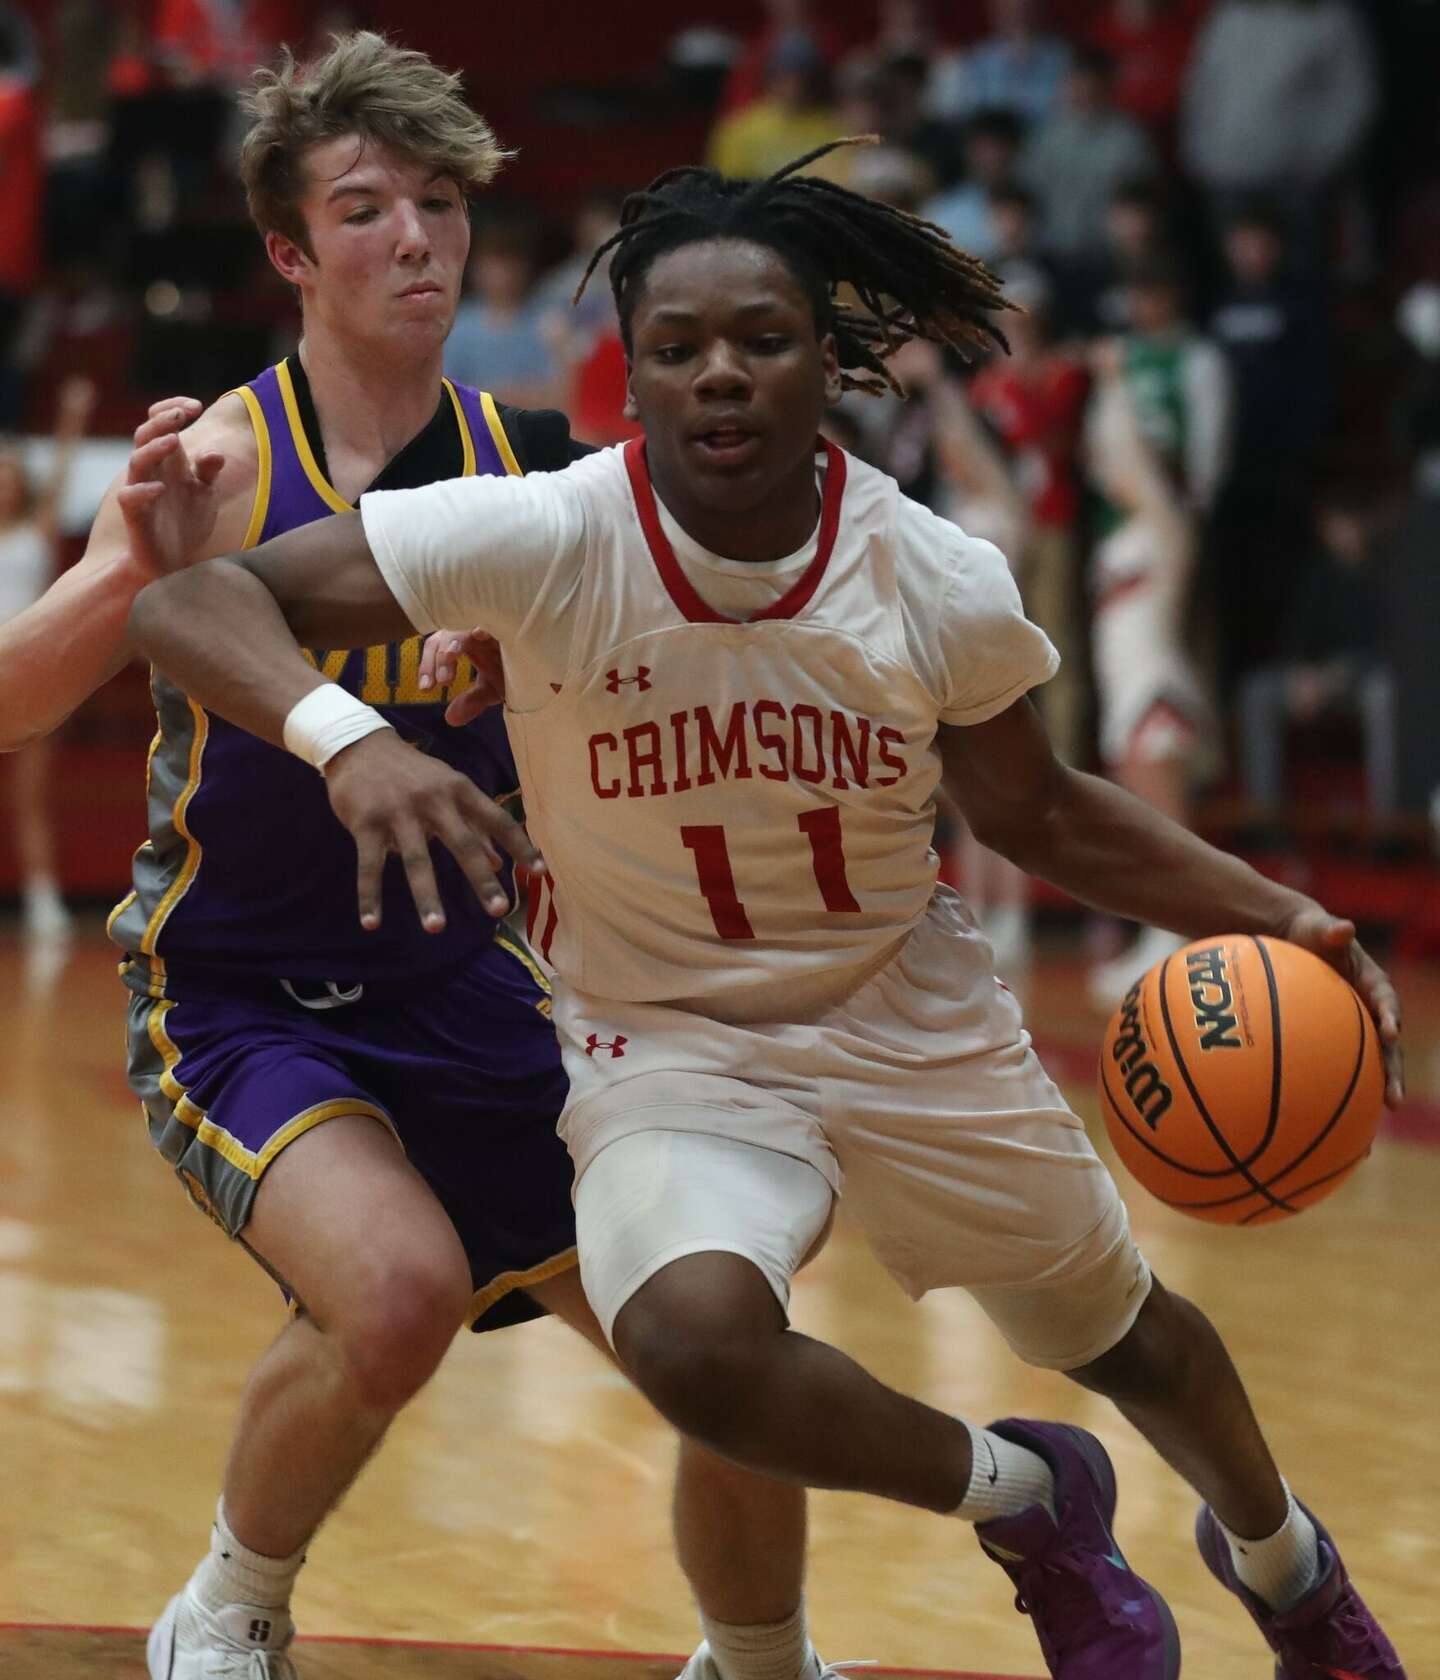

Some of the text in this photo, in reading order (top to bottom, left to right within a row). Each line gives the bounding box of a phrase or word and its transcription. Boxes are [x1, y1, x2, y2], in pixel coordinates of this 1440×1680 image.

[588, 700, 908, 799] CRIMSONS
[680, 804, 862, 940] 11
[1186, 945, 1242, 1051] NCAA
